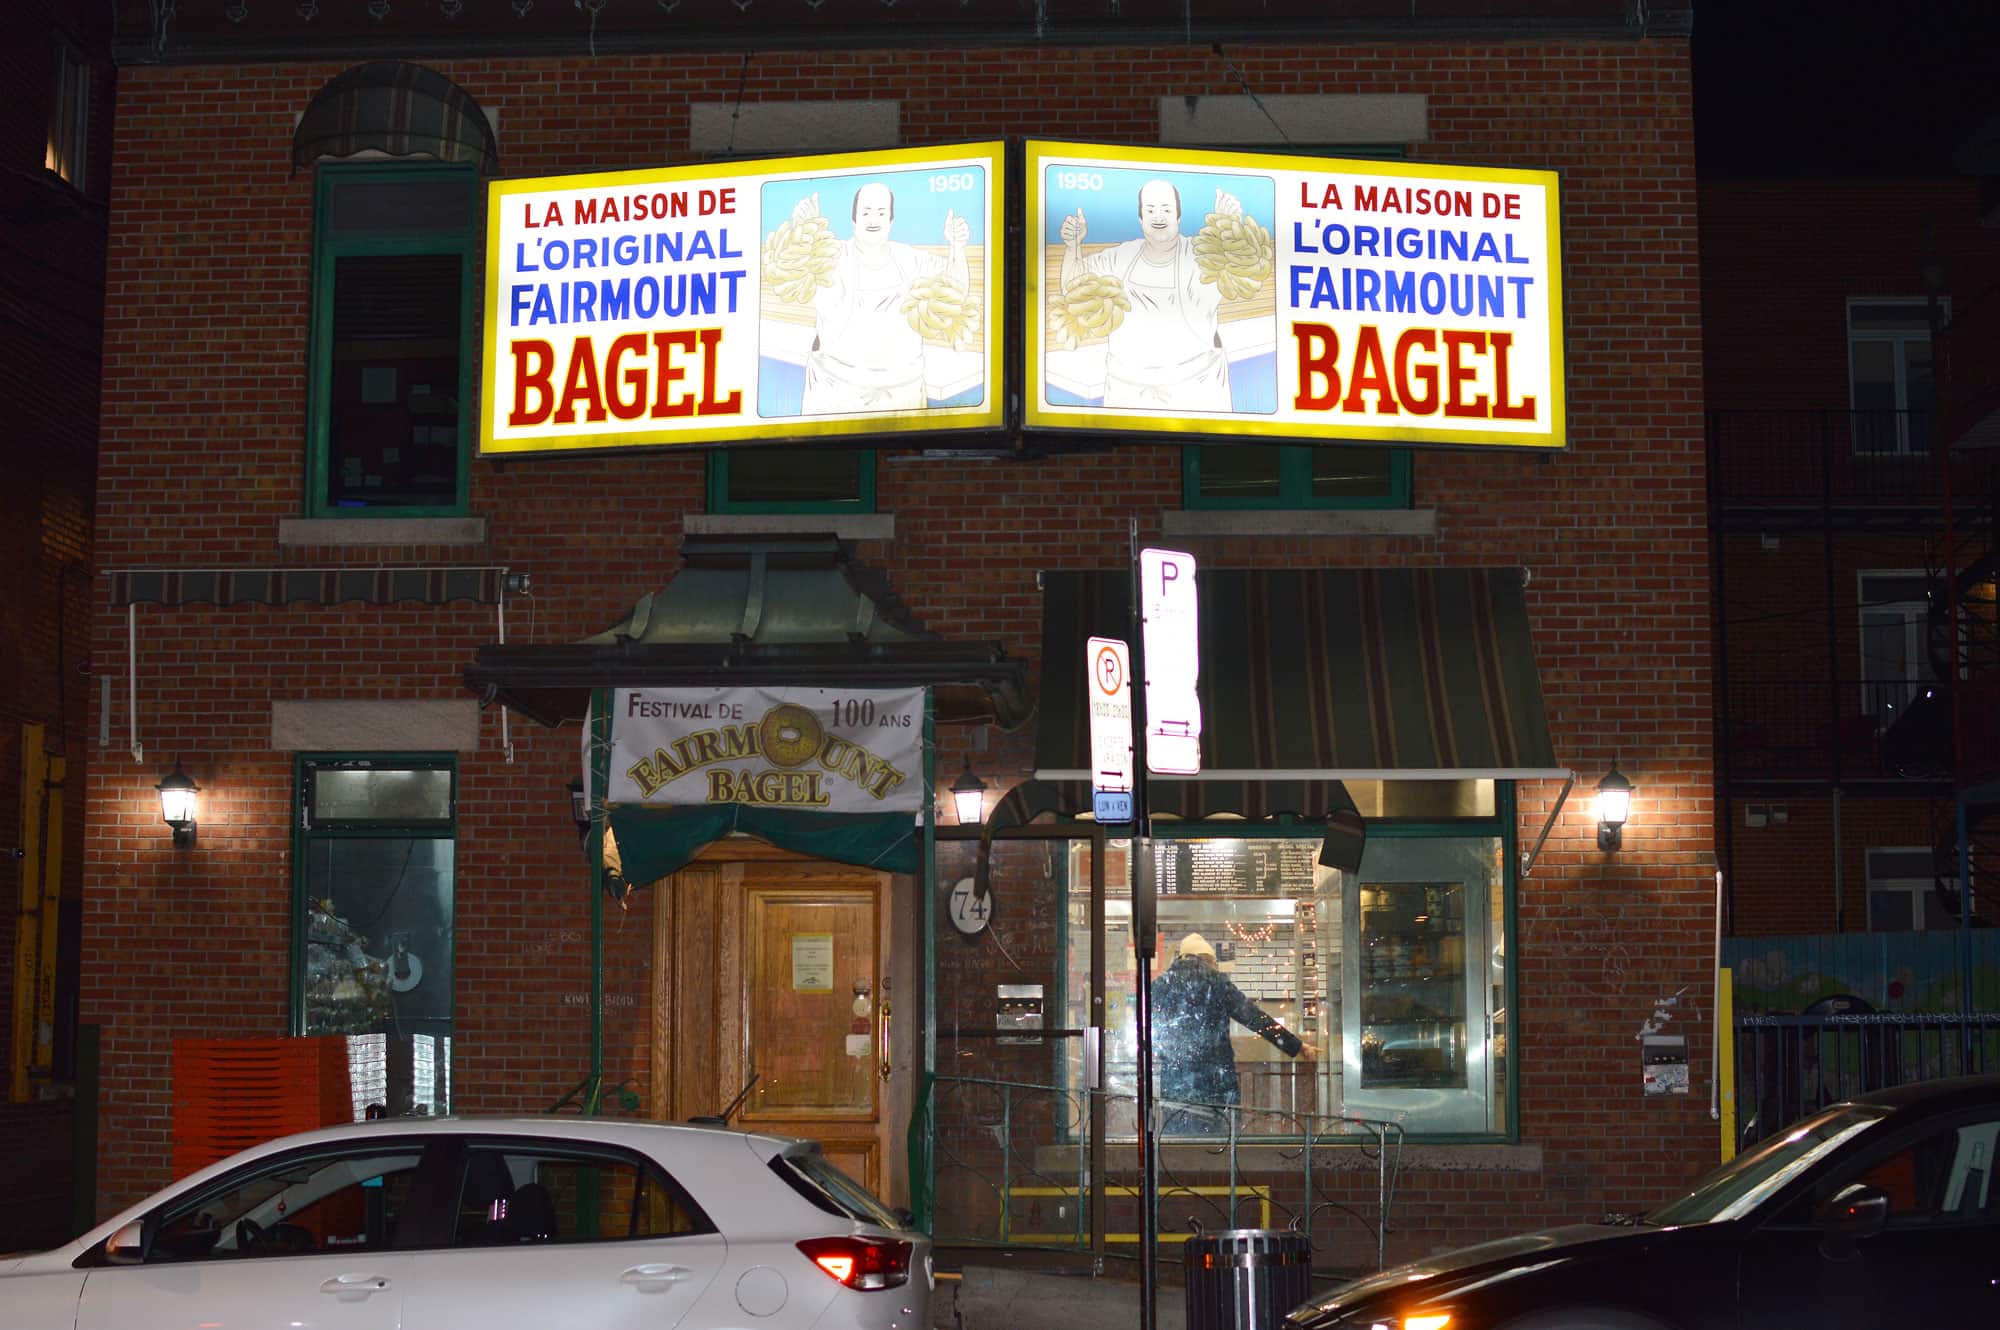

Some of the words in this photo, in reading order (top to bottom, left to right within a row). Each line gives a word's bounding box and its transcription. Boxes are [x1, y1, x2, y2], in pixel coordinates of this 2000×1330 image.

[928, 173, 974, 193] 1950
[1056, 172, 1104, 191] 1950
[1300, 181, 1343, 211] LA
[1355, 185, 1472, 218] MAISON
[1482, 192, 1521, 220] DE
[524, 201, 564, 229] LA
[574, 191, 689, 225] MAISON
[698, 187, 736, 215] DE
[515, 228, 743, 273] L'ORIGINAL
[1293, 219, 1530, 264] L'ORIGINAL
[510, 270, 746, 327] FAIRMOUNT
[1290, 264, 1534, 319] FAIRMOUNT
[507, 326, 742, 428] BAGEL
[1290, 320, 1537, 422] BAGEL
[1161, 561, 1178, 596] P
[627, 692, 712, 720] FESTIVAL
[719, 702, 743, 720] DE
[831, 698, 875, 728] 100
[878, 714, 912, 728] ANS
[706, 768, 830, 807] BAGEL
[954, 891, 988, 921] 74
